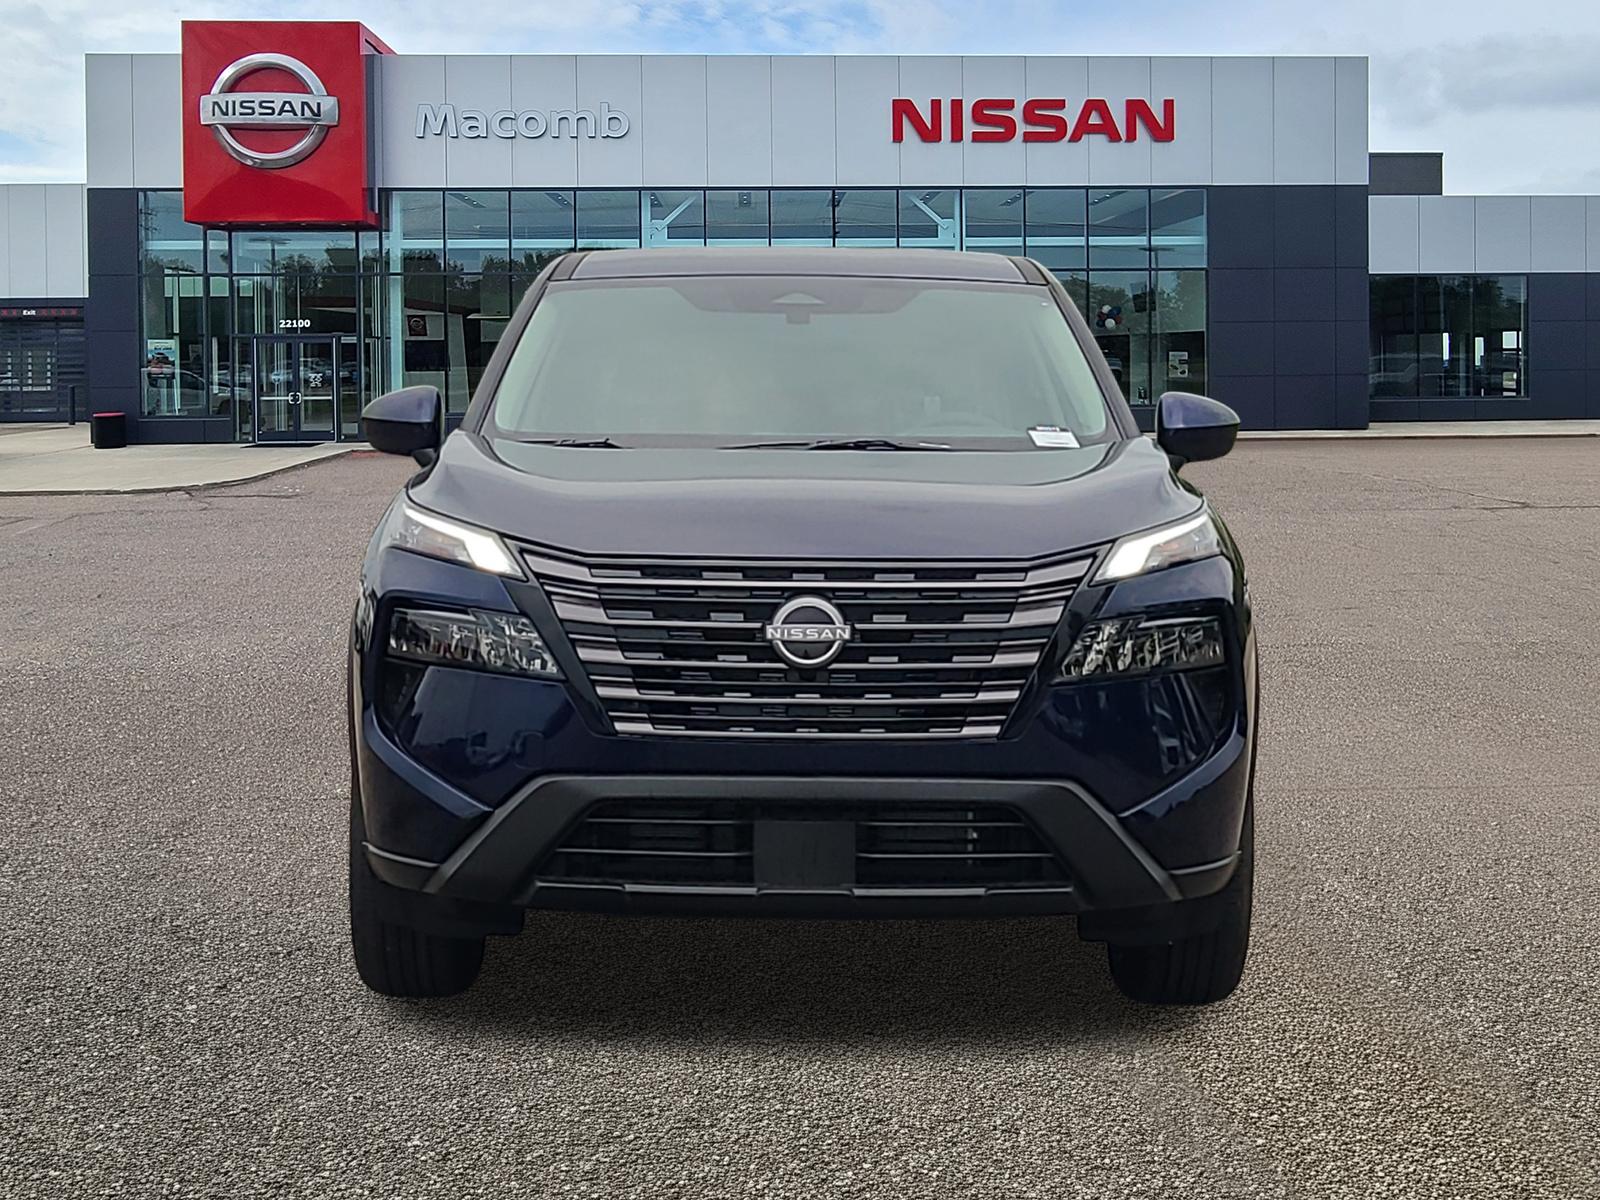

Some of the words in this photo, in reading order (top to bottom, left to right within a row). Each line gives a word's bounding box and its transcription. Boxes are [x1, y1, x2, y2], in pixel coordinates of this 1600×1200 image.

[212, 100, 322, 118] NISSAN
[415, 102, 630, 139] Macomb
[892, 98, 1175, 143] NISSAN
[279, 319, 311, 328] 22100
[767, 628, 850, 640] NISSAN
